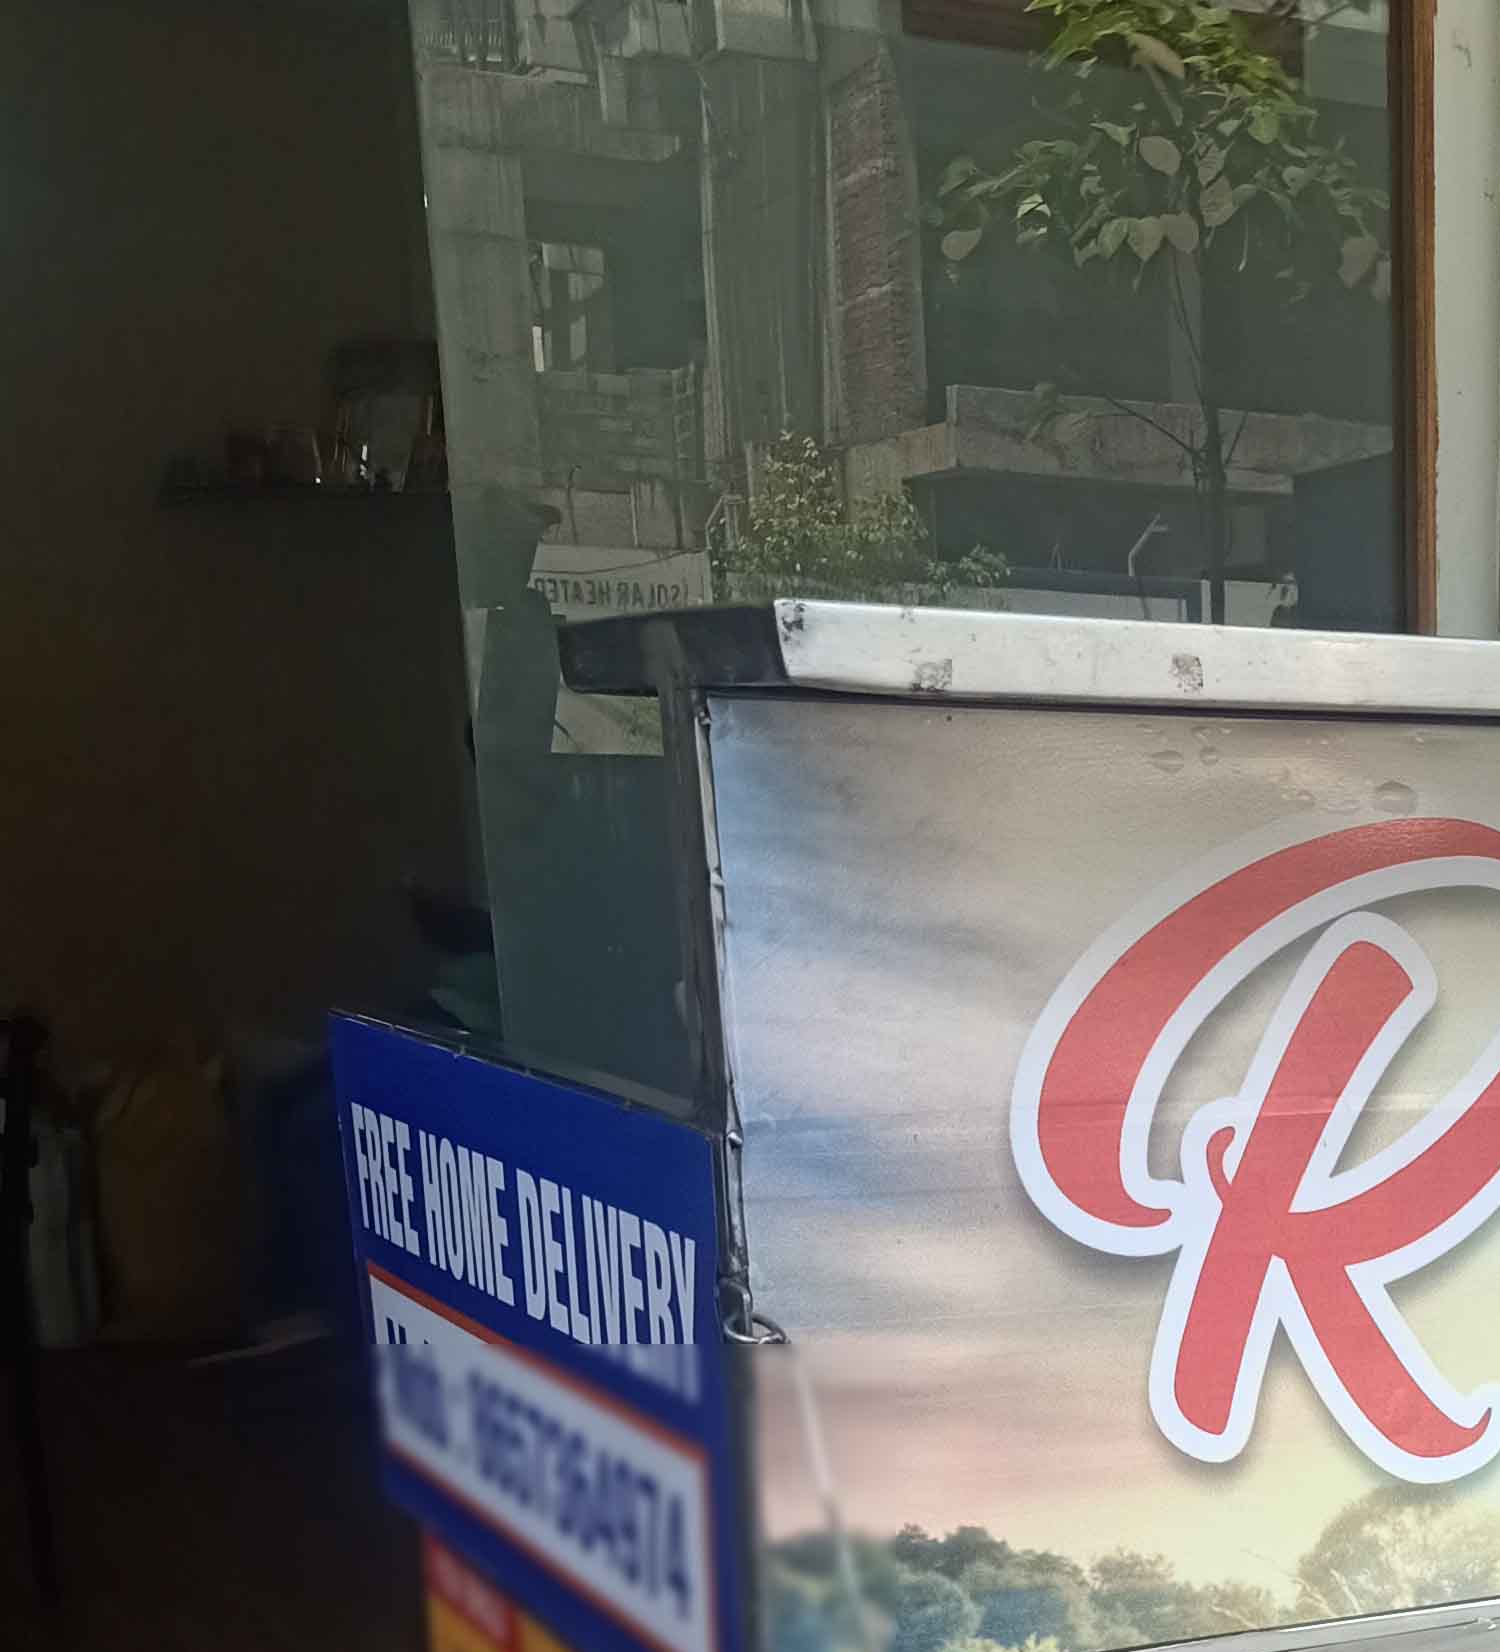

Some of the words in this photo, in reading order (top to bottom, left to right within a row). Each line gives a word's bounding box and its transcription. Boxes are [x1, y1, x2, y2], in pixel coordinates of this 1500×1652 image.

[351, 1101, 421, 1257] FREE
[419, 1129, 515, 1307] HOME
[516, 1167, 698, 1402] DELIVERY
